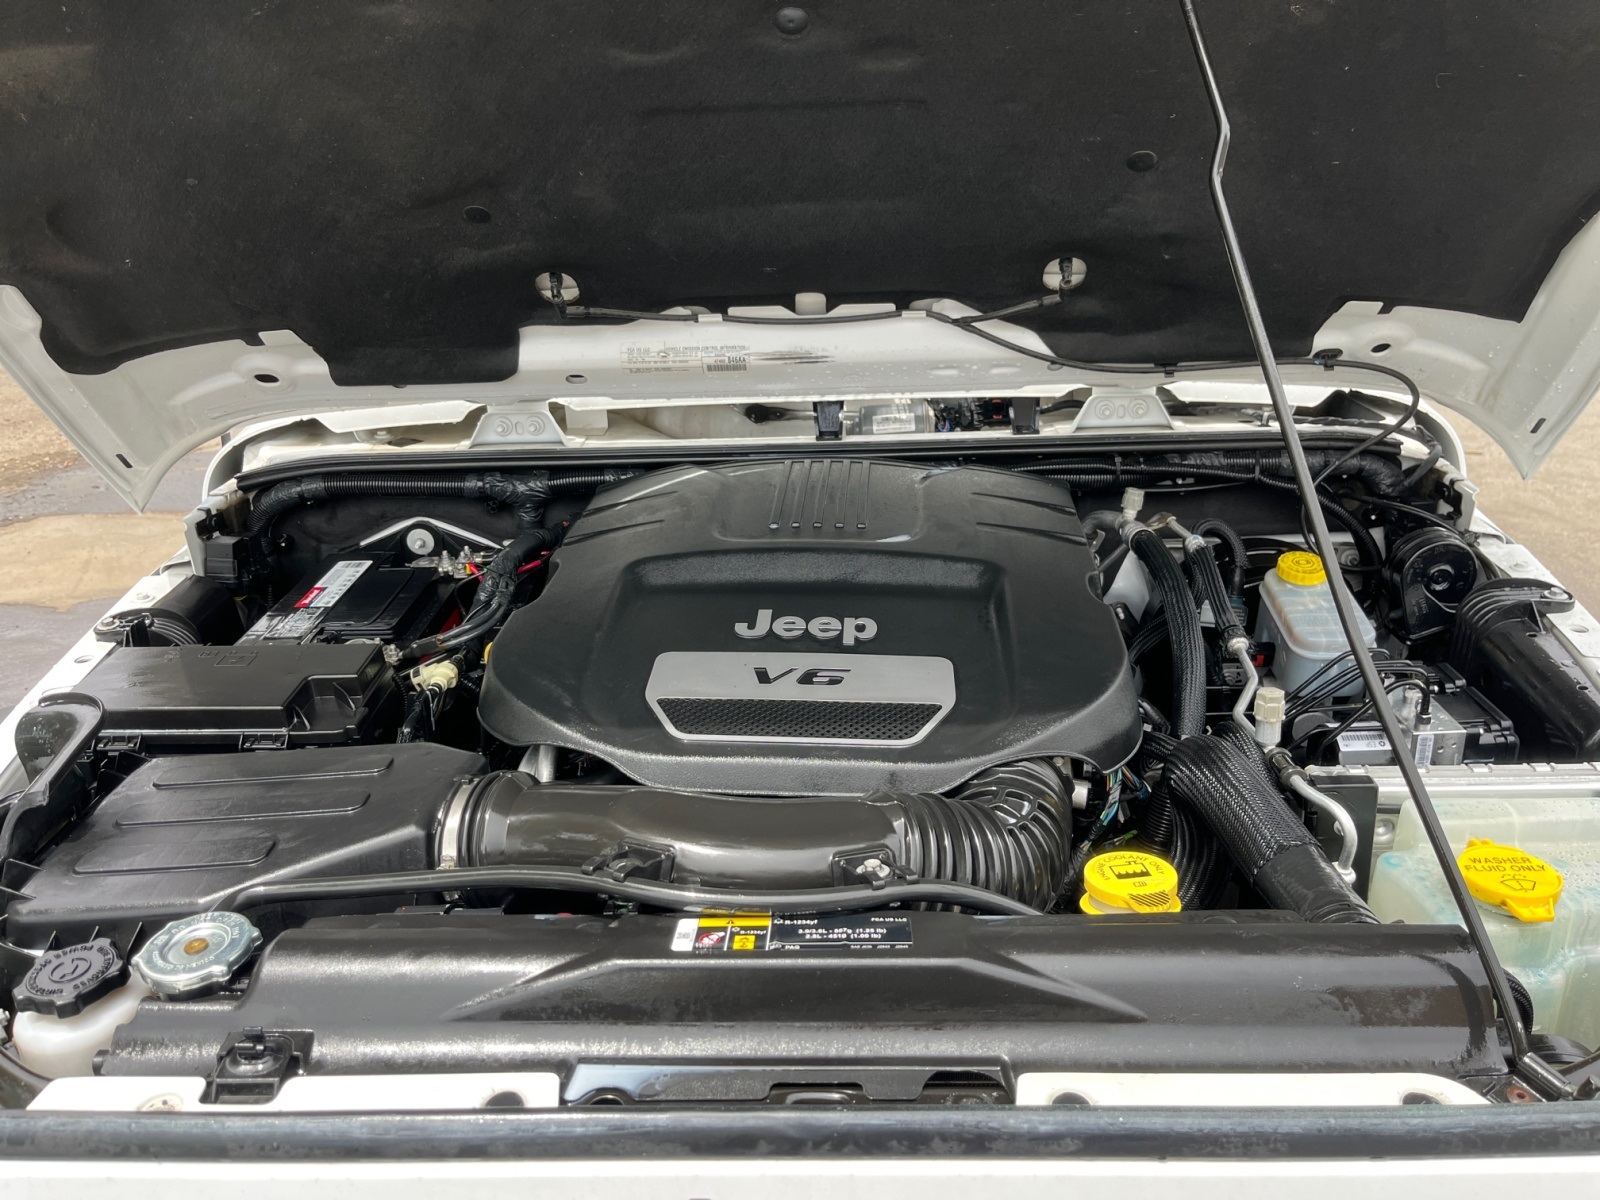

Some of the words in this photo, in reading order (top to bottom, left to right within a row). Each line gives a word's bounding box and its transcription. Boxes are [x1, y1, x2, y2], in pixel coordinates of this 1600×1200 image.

[734, 608, 878, 646] Jeep
[753, 667, 852, 686] V6
[1103, 854, 1148, 863] COOLANT
[1149, 860, 1165, 875] ONLY
